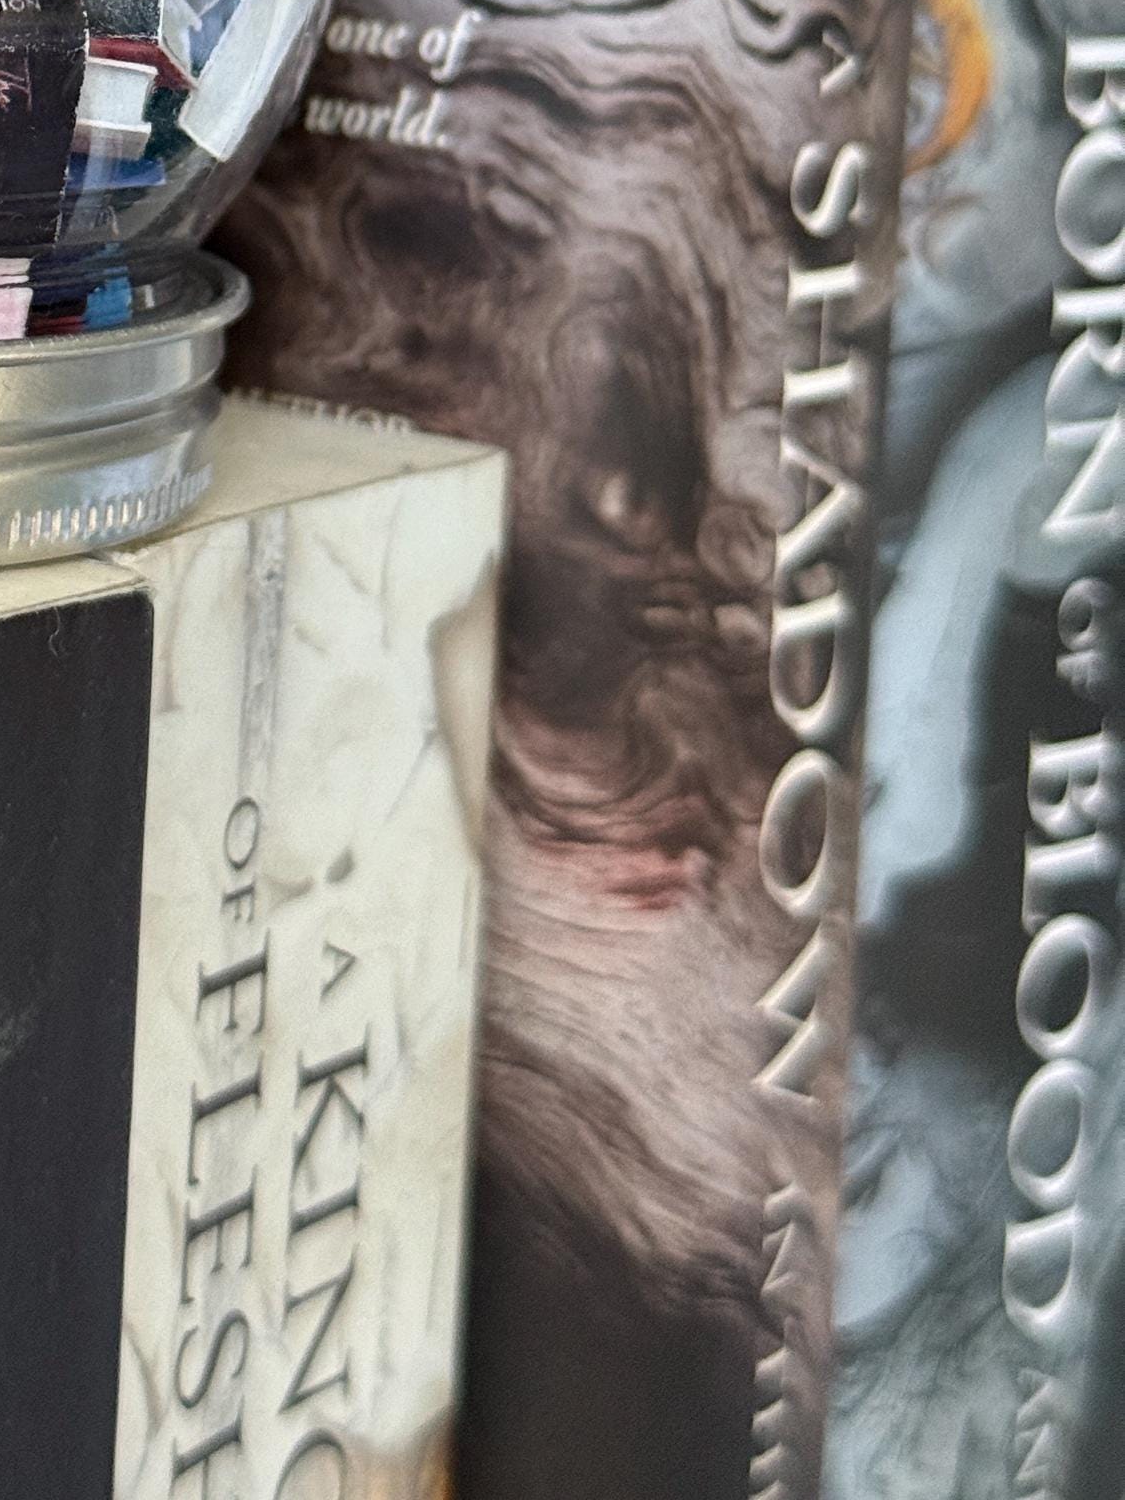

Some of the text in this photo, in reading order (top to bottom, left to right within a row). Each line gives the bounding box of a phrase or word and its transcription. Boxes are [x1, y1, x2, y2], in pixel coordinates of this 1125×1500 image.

[326, 8, 483, 83] one of
[818, 30, 862, 100] A
[303, 85, 450, 148] world.
[1039, 34, 1125, 538] BORN
[748, 140, 872, 1106] SHADOW
[1055, 574, 1111, 697] OF
[221, 796, 261, 924] OF
[321, 941, 359, 1003] A
[1002, 715, 1123, 1348] BLOOD
